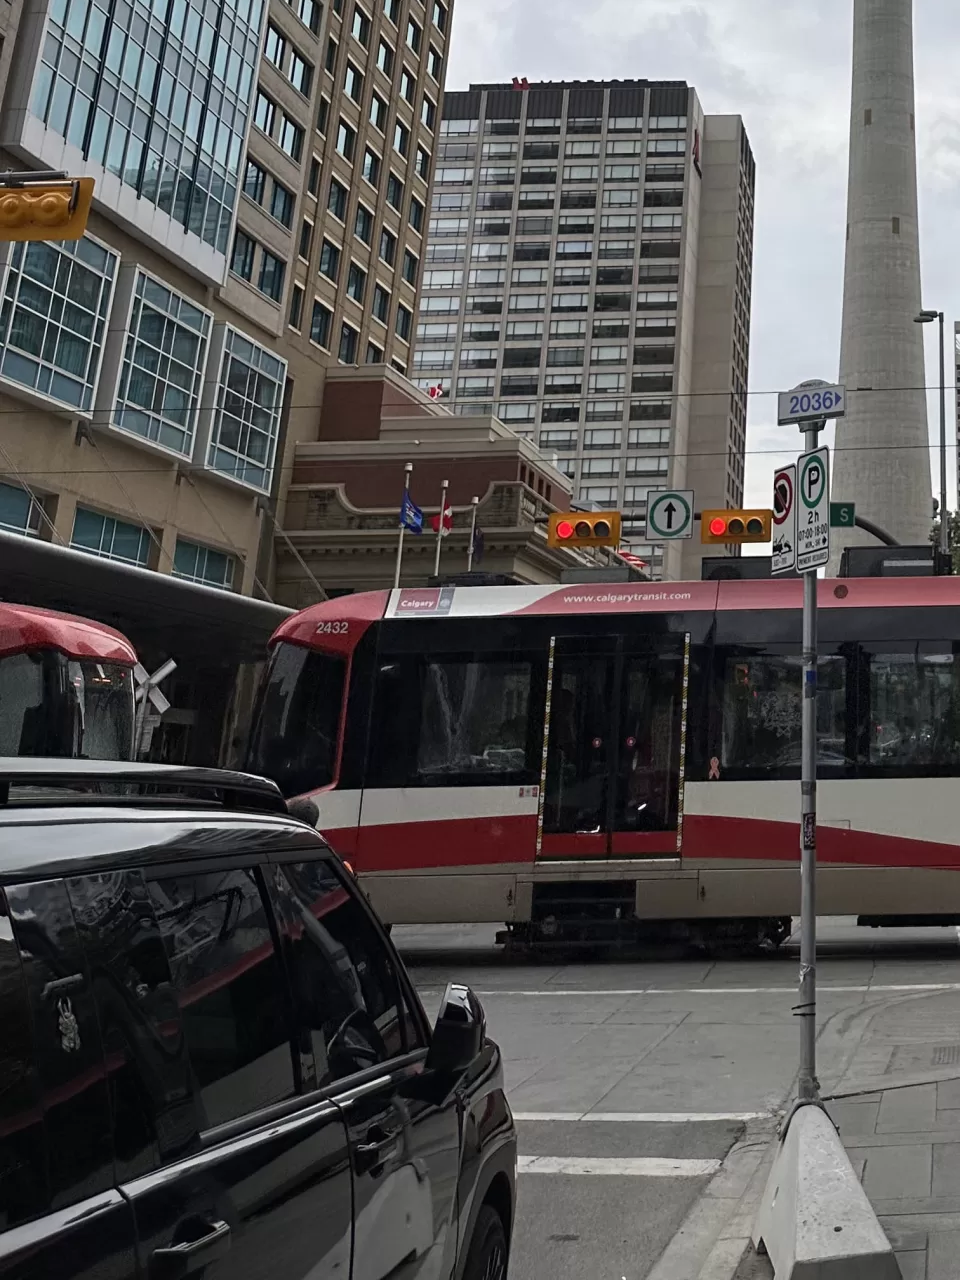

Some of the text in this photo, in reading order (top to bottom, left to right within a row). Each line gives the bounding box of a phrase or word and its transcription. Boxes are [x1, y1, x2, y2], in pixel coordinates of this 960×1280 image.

[790, 391, 833, 414] 2036
[808, 465, 820, 499] P
[840, 507, 849, 522] S
[401, 600, 434, 608] Calgary
[563, 592, 691, 603] www.calgarytransit.com
[316, 621, 349, 634] 2432
